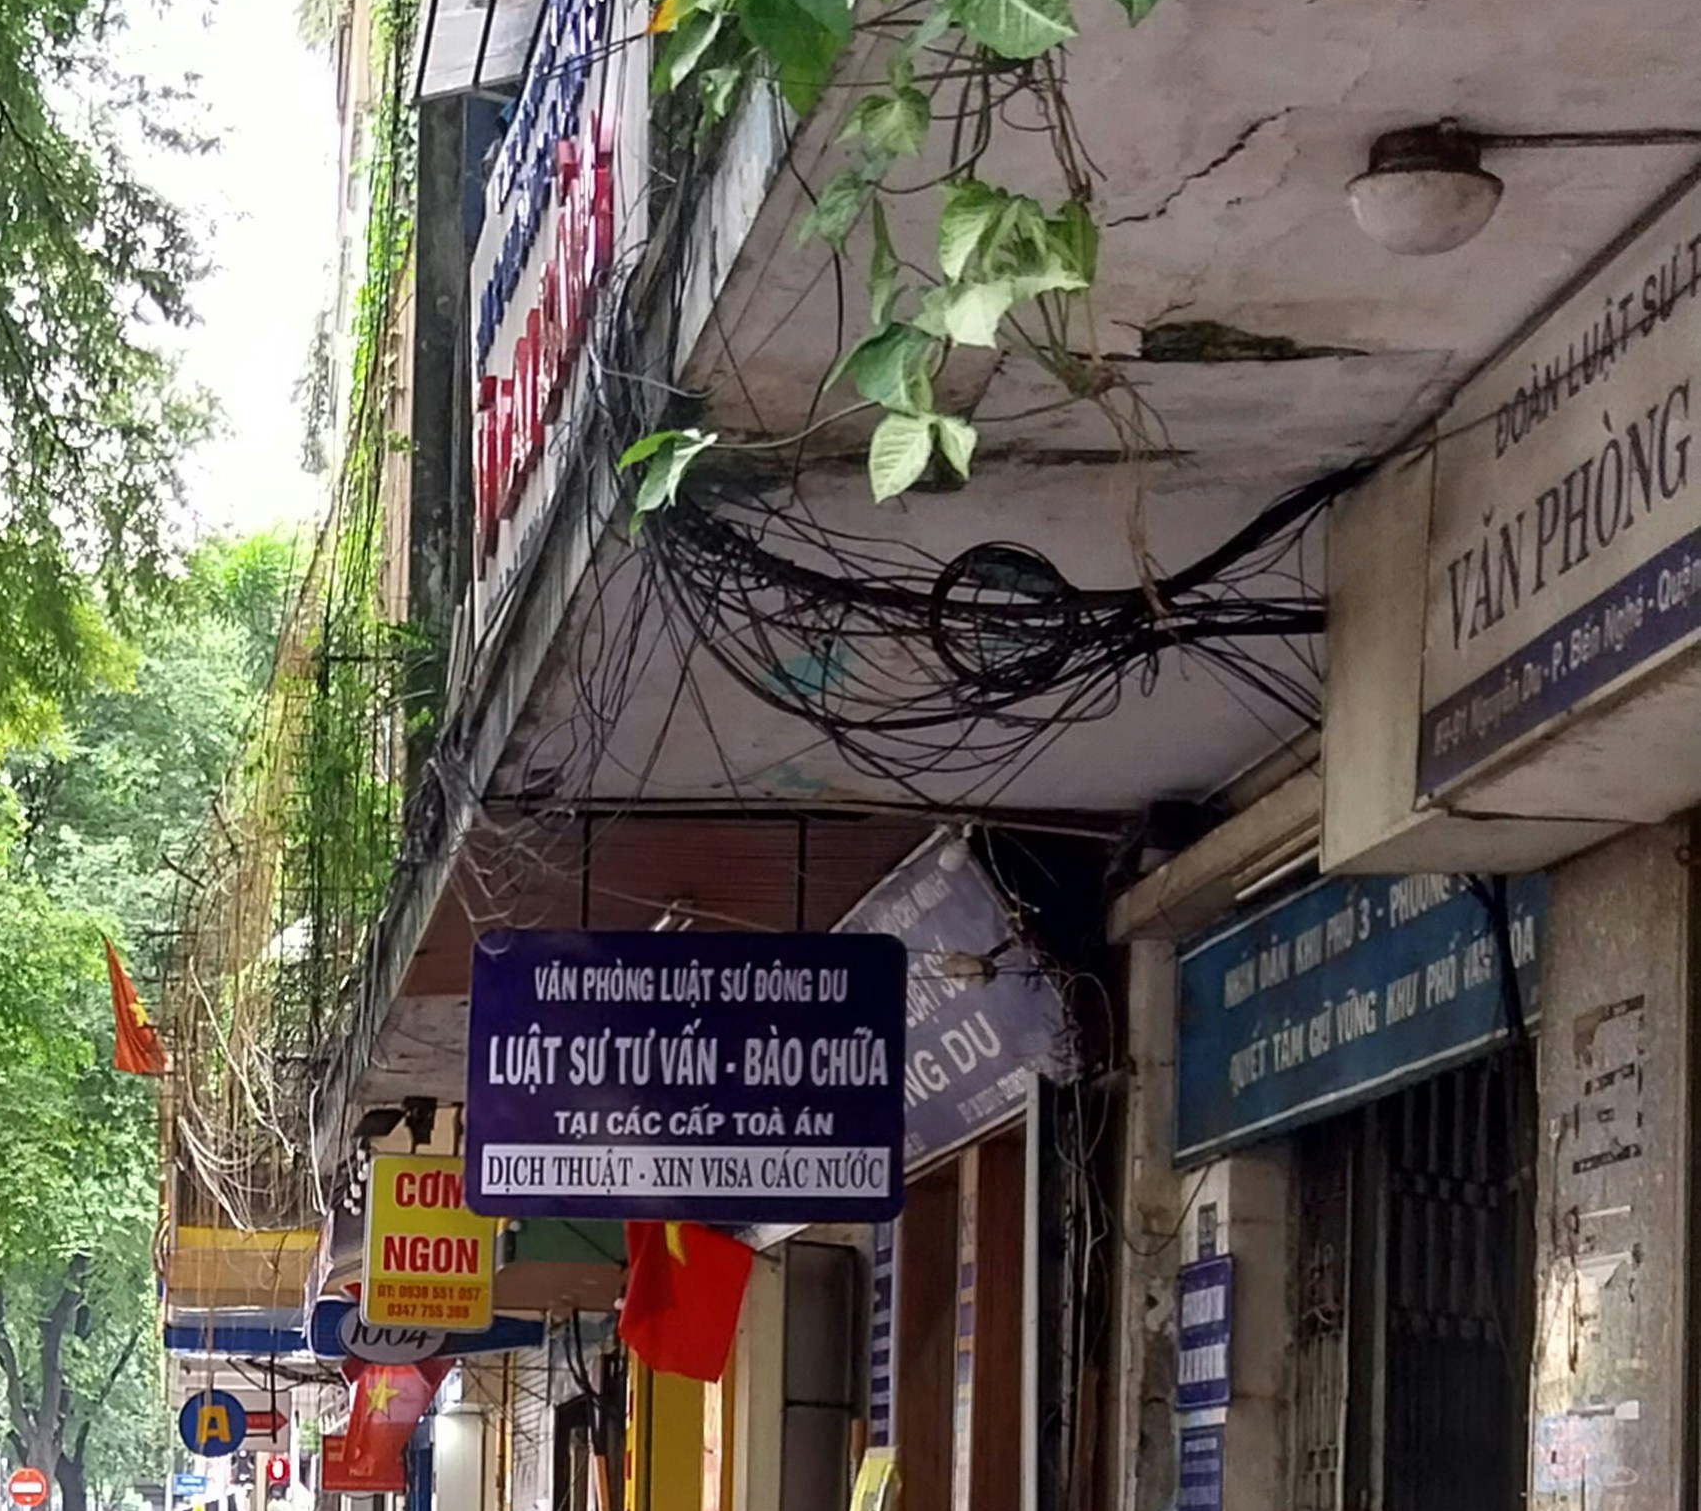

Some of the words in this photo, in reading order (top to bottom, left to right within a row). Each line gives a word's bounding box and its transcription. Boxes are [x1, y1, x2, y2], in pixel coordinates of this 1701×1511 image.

[1568, 292, 1634, 397] LUẬT
[1447, 505, 1527, 651] VĂN
[1532, 379, 1692, 596] PHÒNG
[1603, 581, 1645, 653] Nghé
[1358, 897, 1372, 941] 3
[534, 959, 579, 1002] VĂN
[583, 958, 655, 1002] PHÒNG
[660, 959, 716, 1009] LUẬT
[720, 962, 751, 1002] SƯ
[754, 959, 813, 1003] ĐÔNG
[818, 968, 849, 1003] DU
[1272, 1018, 1304, 1074] TÂM
[1335, 988, 1378, 1045] VỮNG
[1386, 971, 1419, 1026] KHU
[1425, 930, 1460, 1009] PHỐ
[488, 1022, 563, 1095] LUẬT
[568, 1027, 612, 1087] SƯ
[614, 1027, 656, 1087] TƯ
[658, 1017, 718, 1087] VẤN
[810, 1025, 889, 1087] CHỮA
[939, 1010, 1002, 1076] DU
[553, 1110, 599, 1140] TẠI
[605, 1104, 663, 1137] CÁC
[668, 1102, 726, 1137] CẤP
[732, 1105, 786, 1137] TOÀ
[793, 1105, 835, 1137] ÁN
[395, 1169, 464, 1209] CƠM
[487, 1154, 546, 1194] DỊCH
[552, 1147, 635, 1195] THUẬT
[651, 1156, 696, 1189] XIN
[701, 1156, 754, 1189] VISA
[760, 1148, 810, 1189] CÁC
[815, 1147, 885, 1190] NƯỚC
[382, 1235, 480, 1275] NGON
[196, 1405, 232, 1445] A
